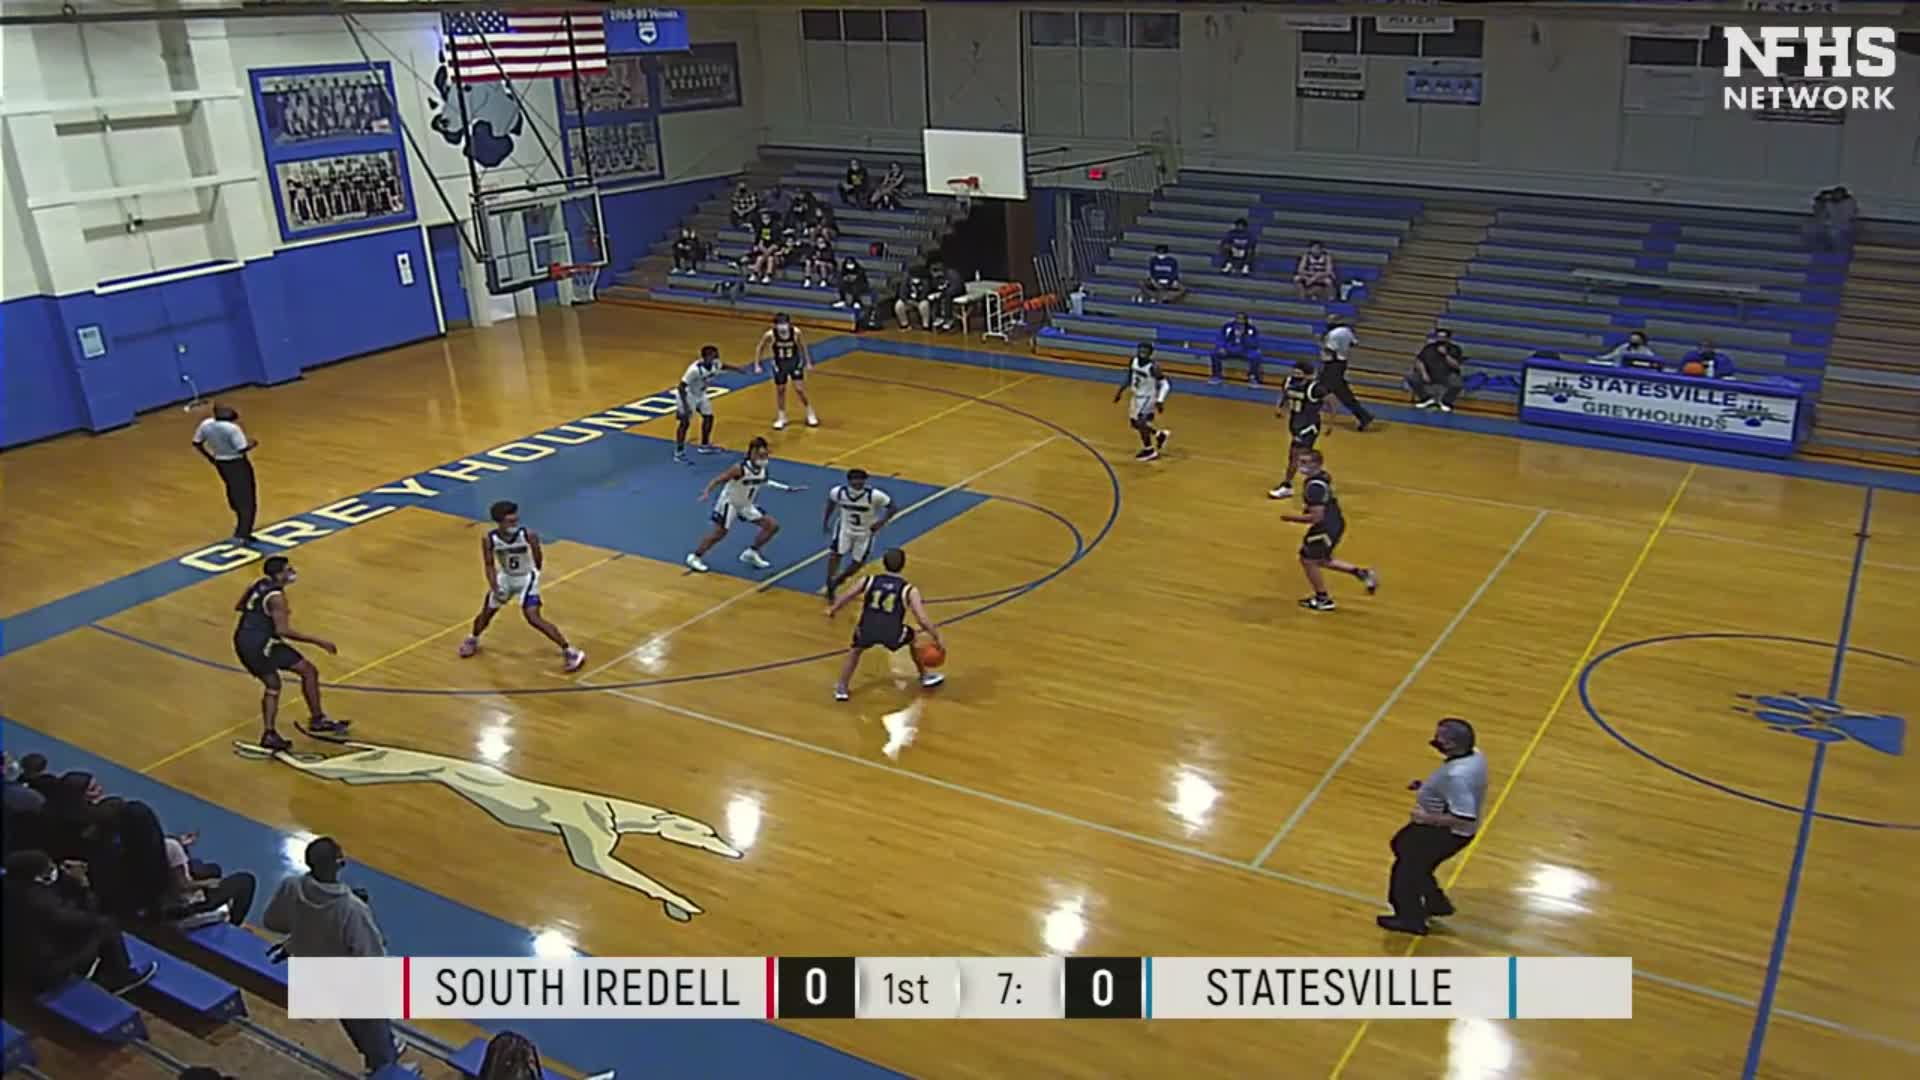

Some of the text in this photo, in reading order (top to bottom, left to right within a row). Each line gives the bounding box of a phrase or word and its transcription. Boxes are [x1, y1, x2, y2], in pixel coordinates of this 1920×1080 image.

[1578, 374, 1738, 408] STATESVILLE
[1581, 400, 1730, 431] GREYHOUNDS
[849, 513, 862, 527] 3
[870, 589, 896, 613] 14
